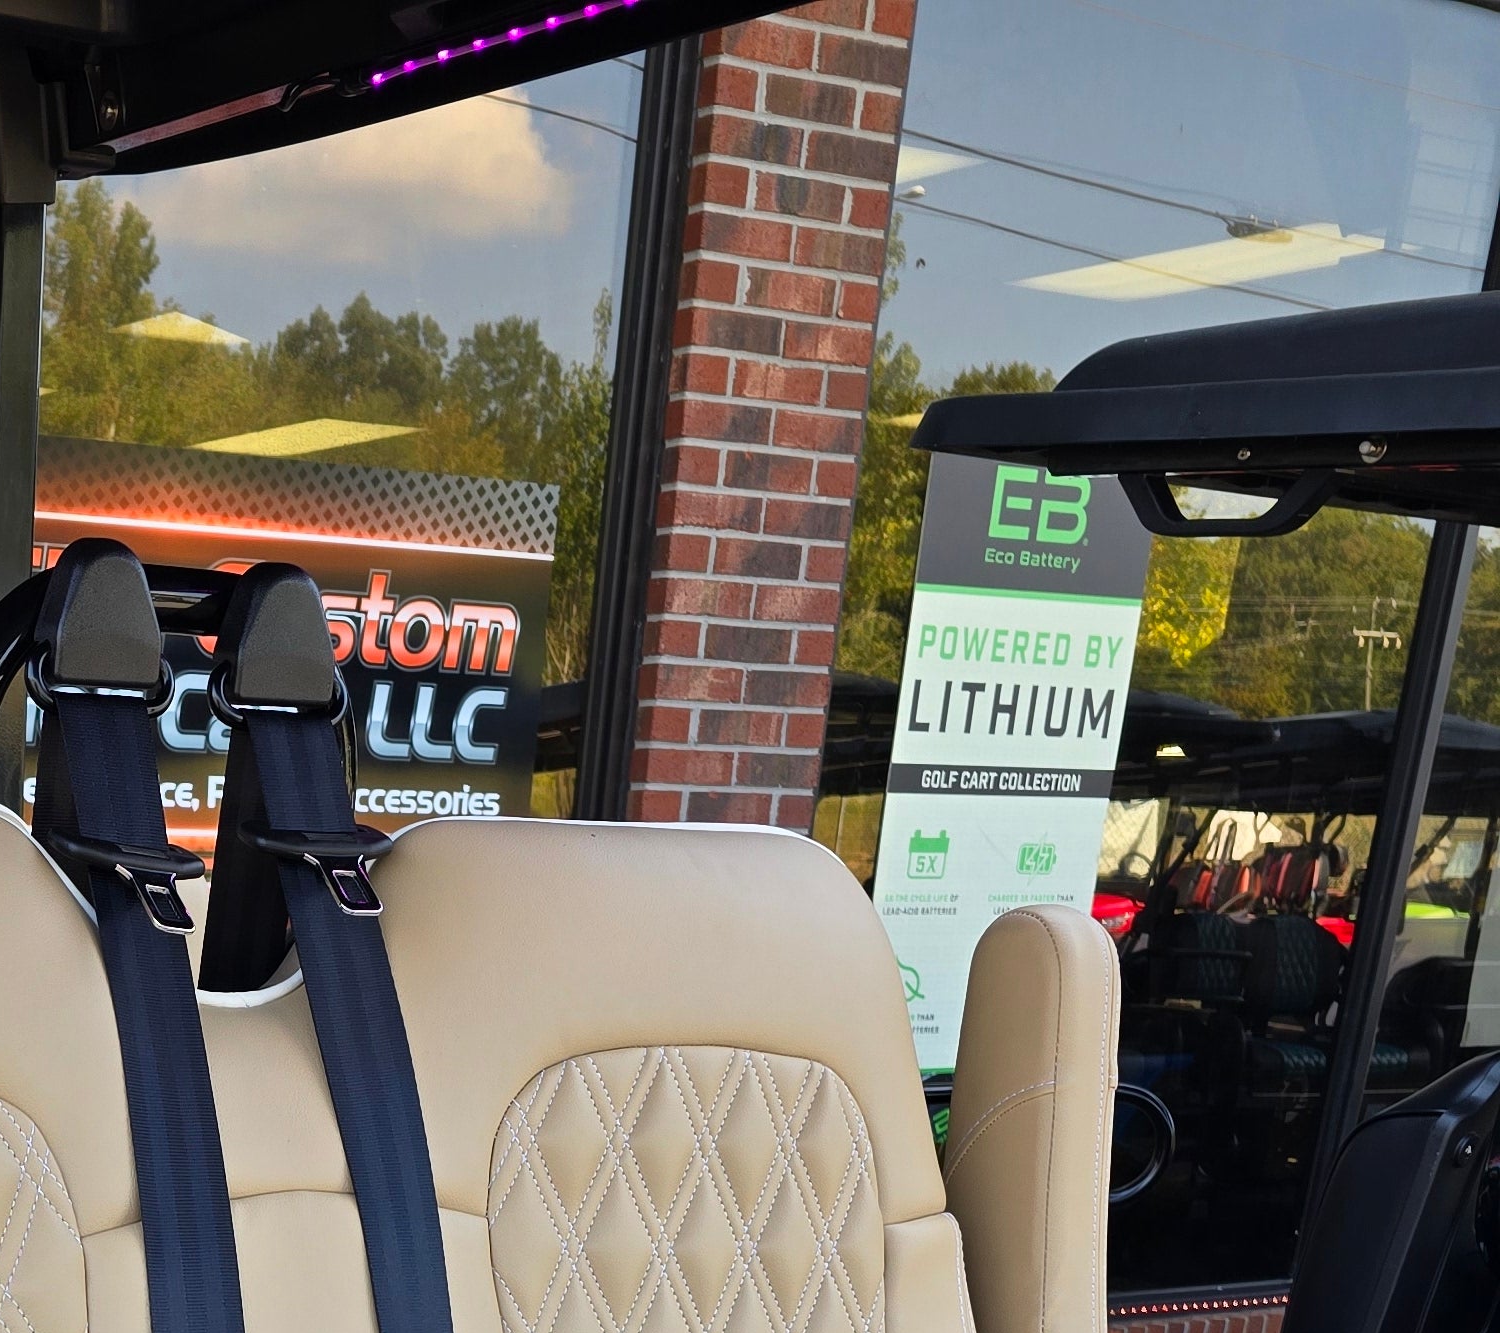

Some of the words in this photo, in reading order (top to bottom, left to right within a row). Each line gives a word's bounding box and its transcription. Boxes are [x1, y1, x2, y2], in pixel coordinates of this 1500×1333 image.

[988, 464, 1092, 545] EB
[984, 547, 1015, 565] Eco
[1019, 550, 1081, 574] Battery
[918, 624, 1071, 666] POWERED
[1083, 635, 1124, 669] BY
[366, 681, 509, 764] LLC
[908, 679, 1115, 739] LITHIUM
[354, 784, 501, 816] ccessories
[921, 770, 958, 789] GOLF
[960, 771, 998, 790] CART
[999, 772, 1082, 792] COLLECTION
[915, 855, 938, 874] 5X
